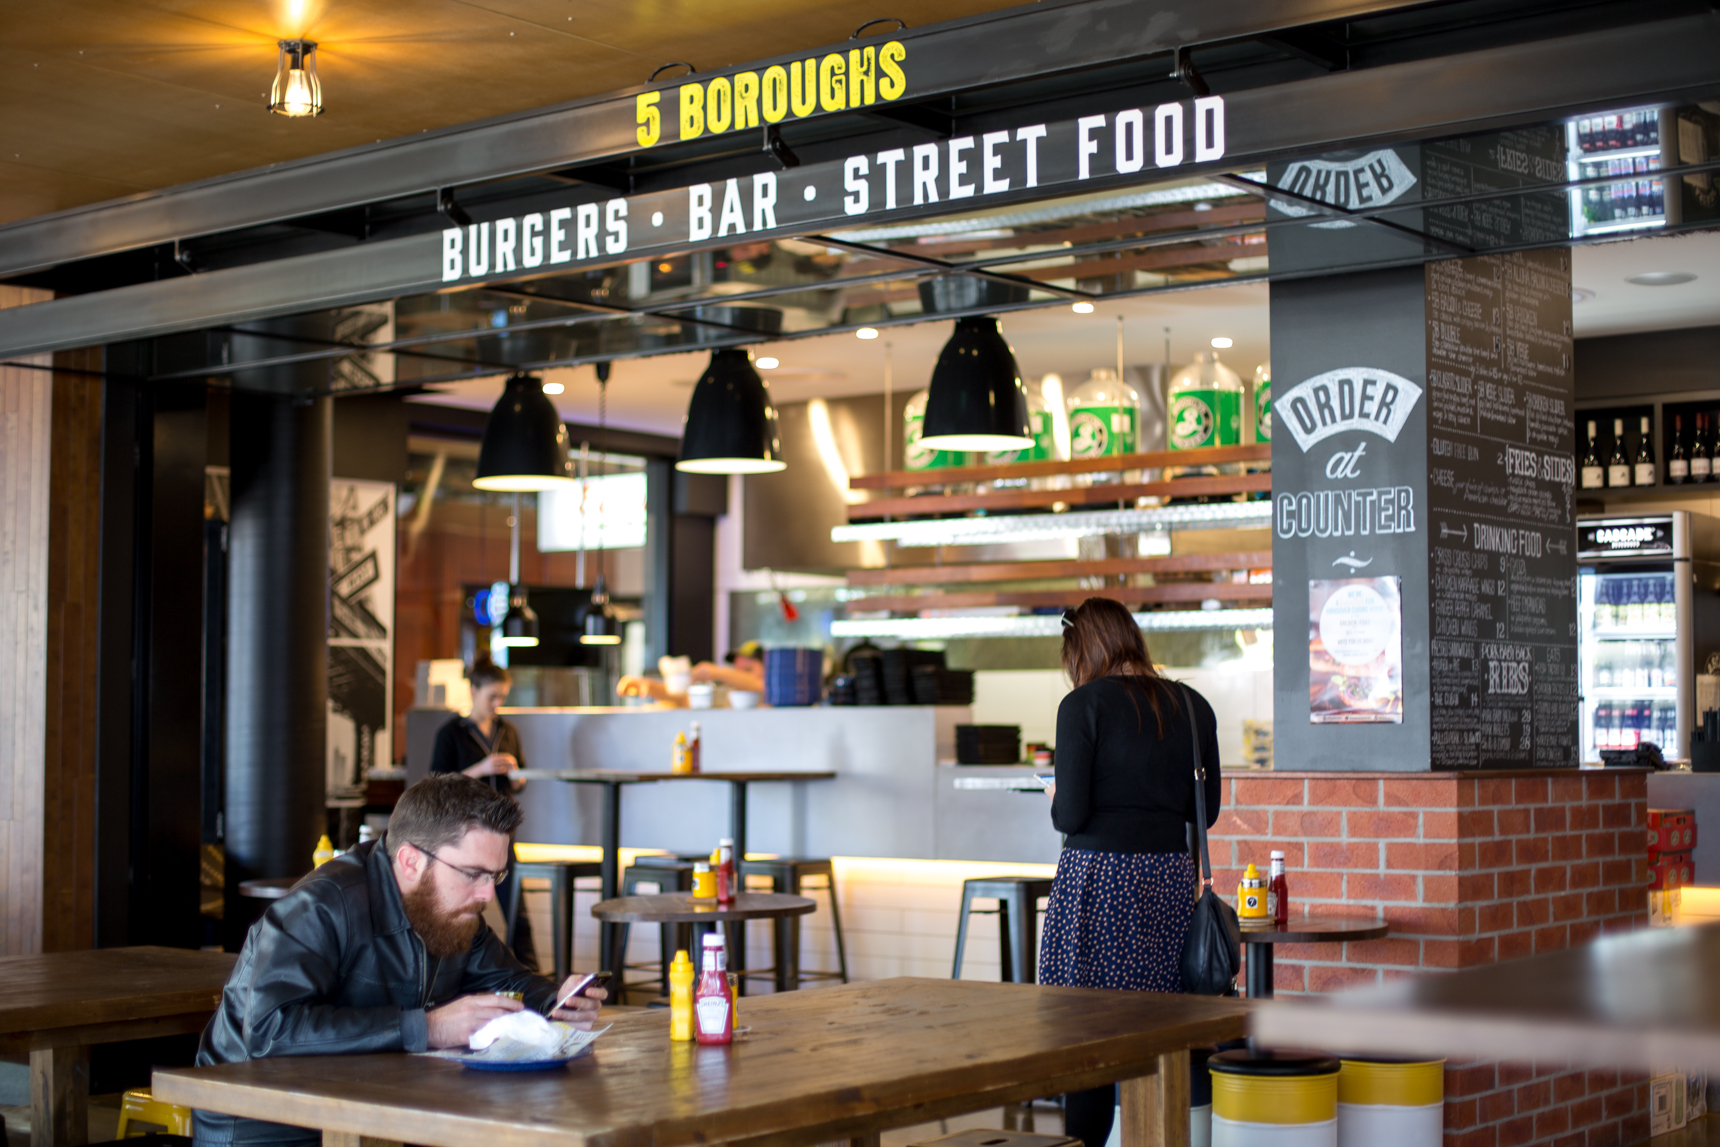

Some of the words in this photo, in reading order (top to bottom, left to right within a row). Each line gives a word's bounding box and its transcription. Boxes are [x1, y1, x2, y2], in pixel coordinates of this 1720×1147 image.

[636, 90, 661, 148] 5
[679, 40, 907, 142] BOROUGHS
[441, 197, 629, 283] BURGERS
[688, 171, 778, 243] BAR
[843, 123, 1048, 217] STREET
[1077, 95, 1225, 181] FOOD
[1289, 377, 1400, 436] ORDER
[1324, 440, 1368, 480] at
[1276, 485, 1416, 539] COUNTER
[1473, 522, 1518, 554] DRINKING
[1518, 529, 1542, 558] FOOD
[1595, 526, 1655, 544] CASCADE
[1470, 551, 1489, 571] CHIPS
[1499, 556, 1506, 574] 9
[1497, 579, 1506, 597] 12
[1496, 621, 1506, 639] 12
[1487, 660, 1530, 695] RIBS
